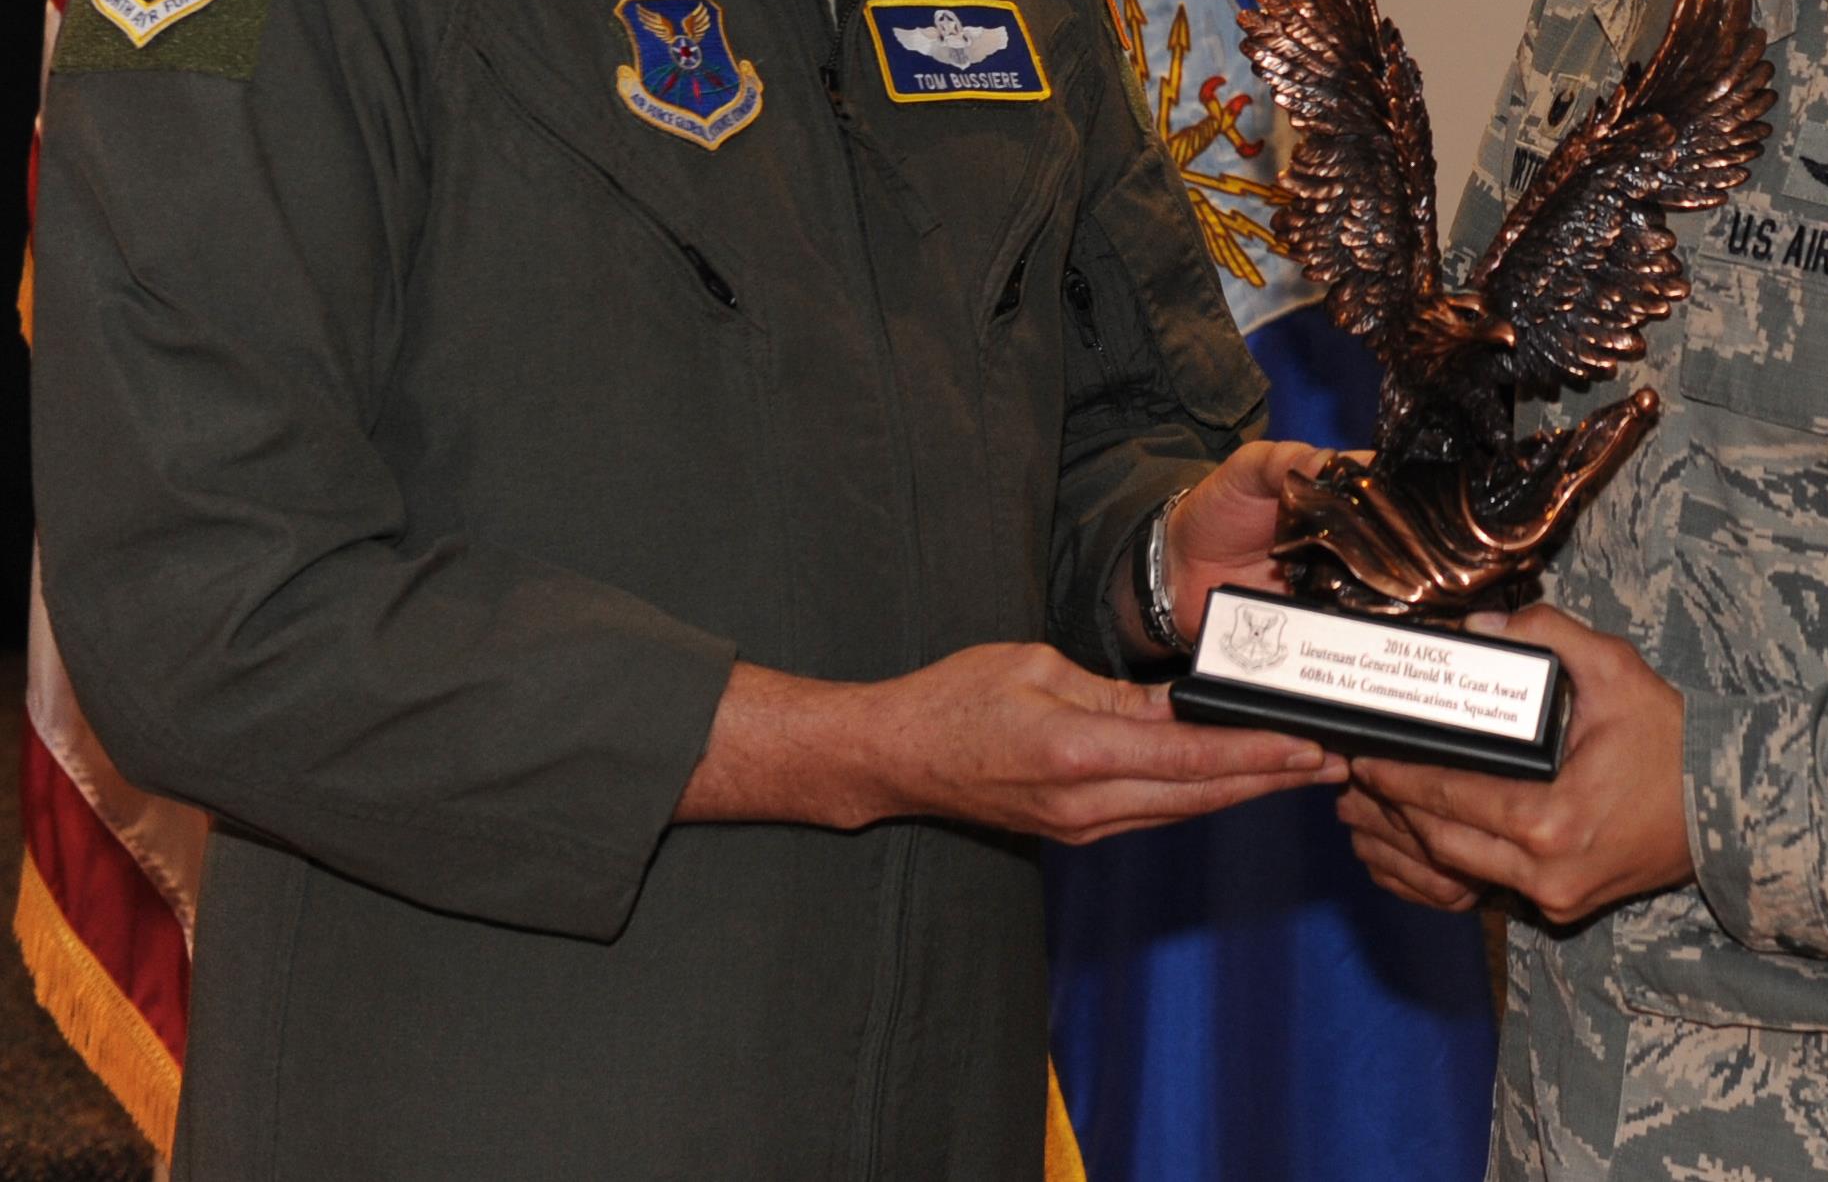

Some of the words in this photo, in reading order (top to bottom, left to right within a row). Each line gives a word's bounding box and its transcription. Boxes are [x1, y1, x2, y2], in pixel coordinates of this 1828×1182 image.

[131, 10, 159, 28] AIR
[914, 73, 947, 90] TOM
[950, 72, 1022, 90] BUSSIERE
[1384, 638, 1411, 657] 2016
[1414, 644, 1454, 666] AFGSC
[1299, 641, 1356, 666] Lieutenant
[1359, 652, 1402, 676] General
[1403, 662, 1440, 684] Harold
[1458, 675, 1490, 694] Grant
[1492, 680, 1529, 702] Award
[1299, 666, 1335, 685] 608th
[1338, 673, 1358, 690] Air
[1359, 677, 1459, 711] Communications
[1463, 700, 1518, 723] Squadron
